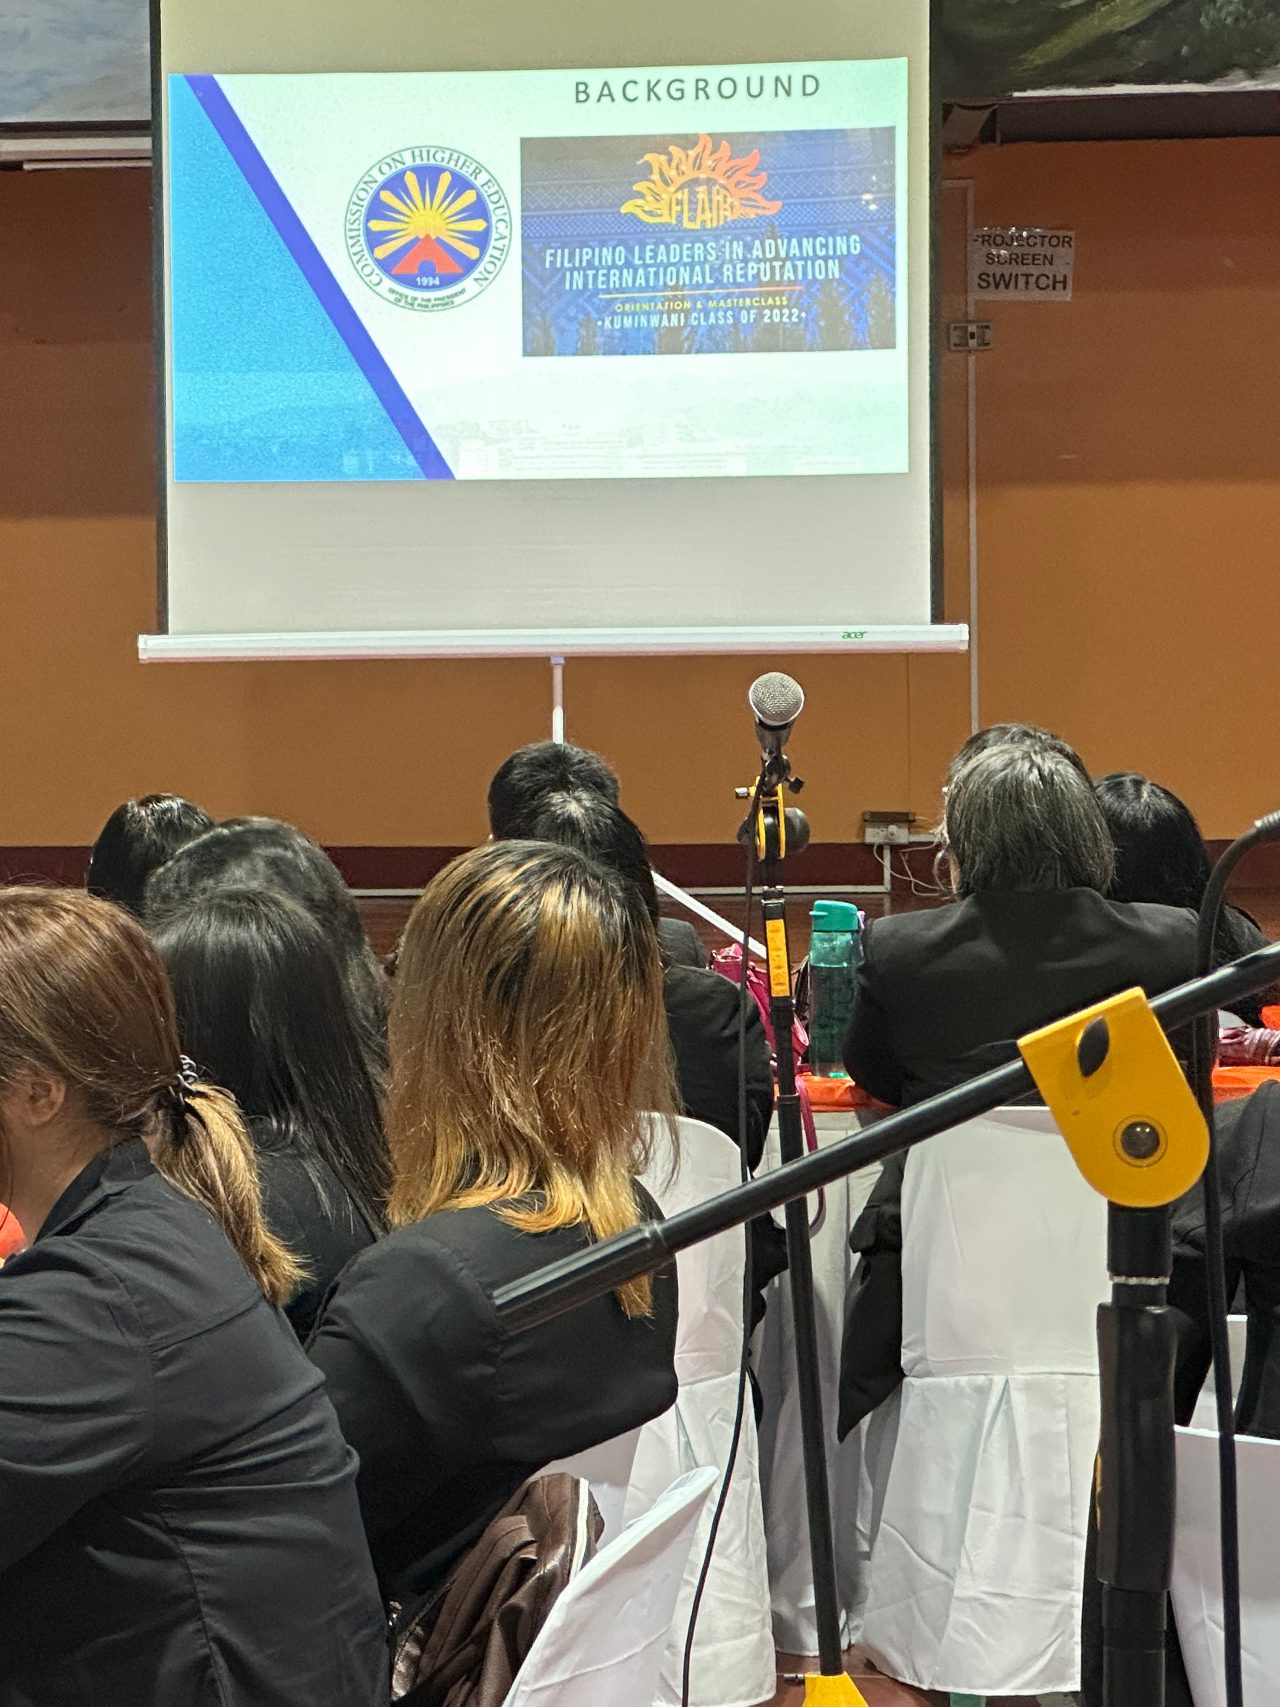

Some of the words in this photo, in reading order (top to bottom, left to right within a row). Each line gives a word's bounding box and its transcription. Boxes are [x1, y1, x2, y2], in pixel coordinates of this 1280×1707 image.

[574, 74, 820, 103] BACKGROUND
[670, 185, 734, 230] FLAIR
[347, 174, 383, 287] COMMISSION
[378, 153, 406, 176] ON
[411, 149, 483, 180] HIGHER
[473, 178, 509, 288] EDUCATION
[545, 245, 626, 269] FILIPINO
[633, 241, 717, 265] LEADERS
[725, 240, 744, 260] IN
[752, 234, 861, 259] ADVANCING
[985, 252, 1054, 266] SCREEN
[416, 276, 440, 286] 1994
[564, 263, 714, 290] INTERNATIONAL
[722, 259, 840, 283] REPUTATION
[977, 272, 1067, 291] SWITCH
[614, 301, 691, 313] ORIENTATION
[708, 296, 788, 308] MASTERCLASS
[691, 309, 734, 326] CLASS
[740, 309, 757, 324] OF
[841, 631, 868, 640] acer
